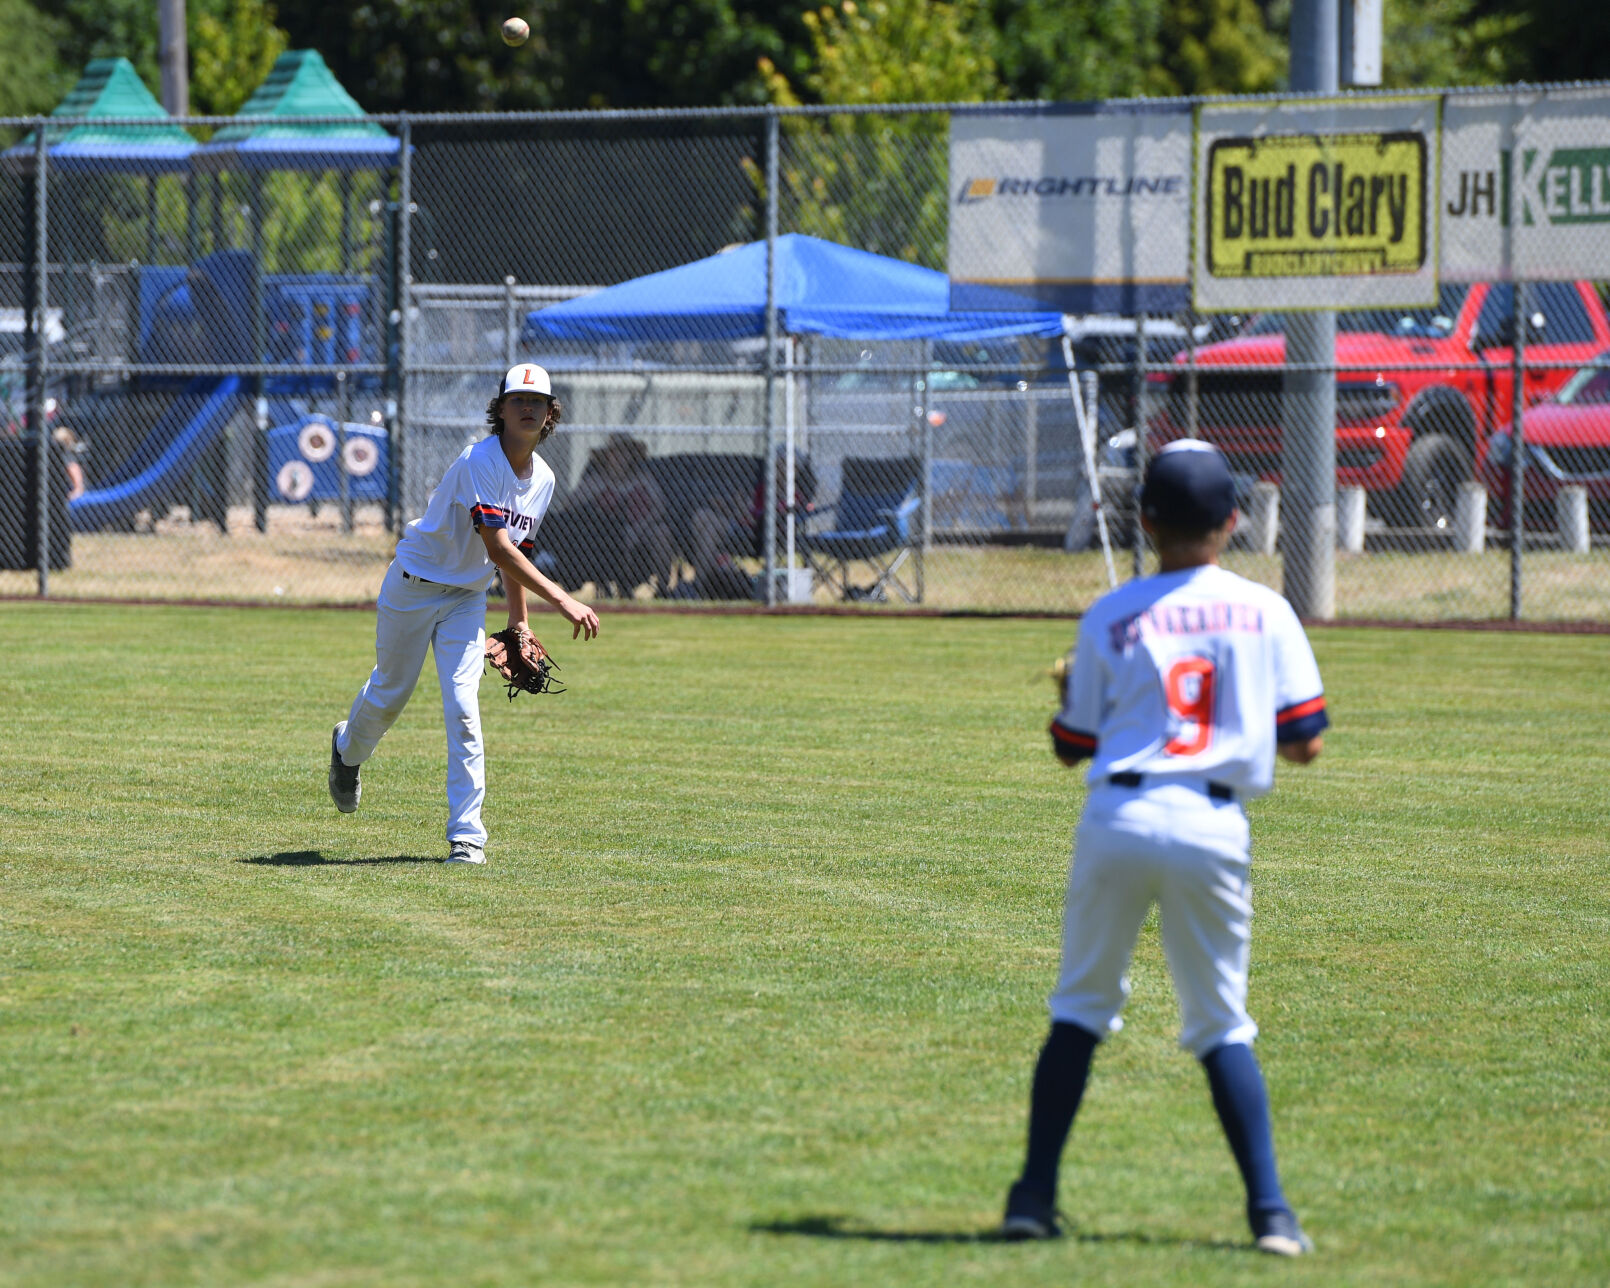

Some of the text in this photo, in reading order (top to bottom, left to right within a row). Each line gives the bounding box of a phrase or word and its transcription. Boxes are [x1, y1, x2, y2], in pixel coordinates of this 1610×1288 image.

[998, 176, 1182, 195] RIGHTLINE
[1223, 162, 1408, 244] Bud Clary
[1447, 147, 1610, 227] JH KELL
[523, 369, 535, 385] L
[1164, 655, 1216, 757] 9
